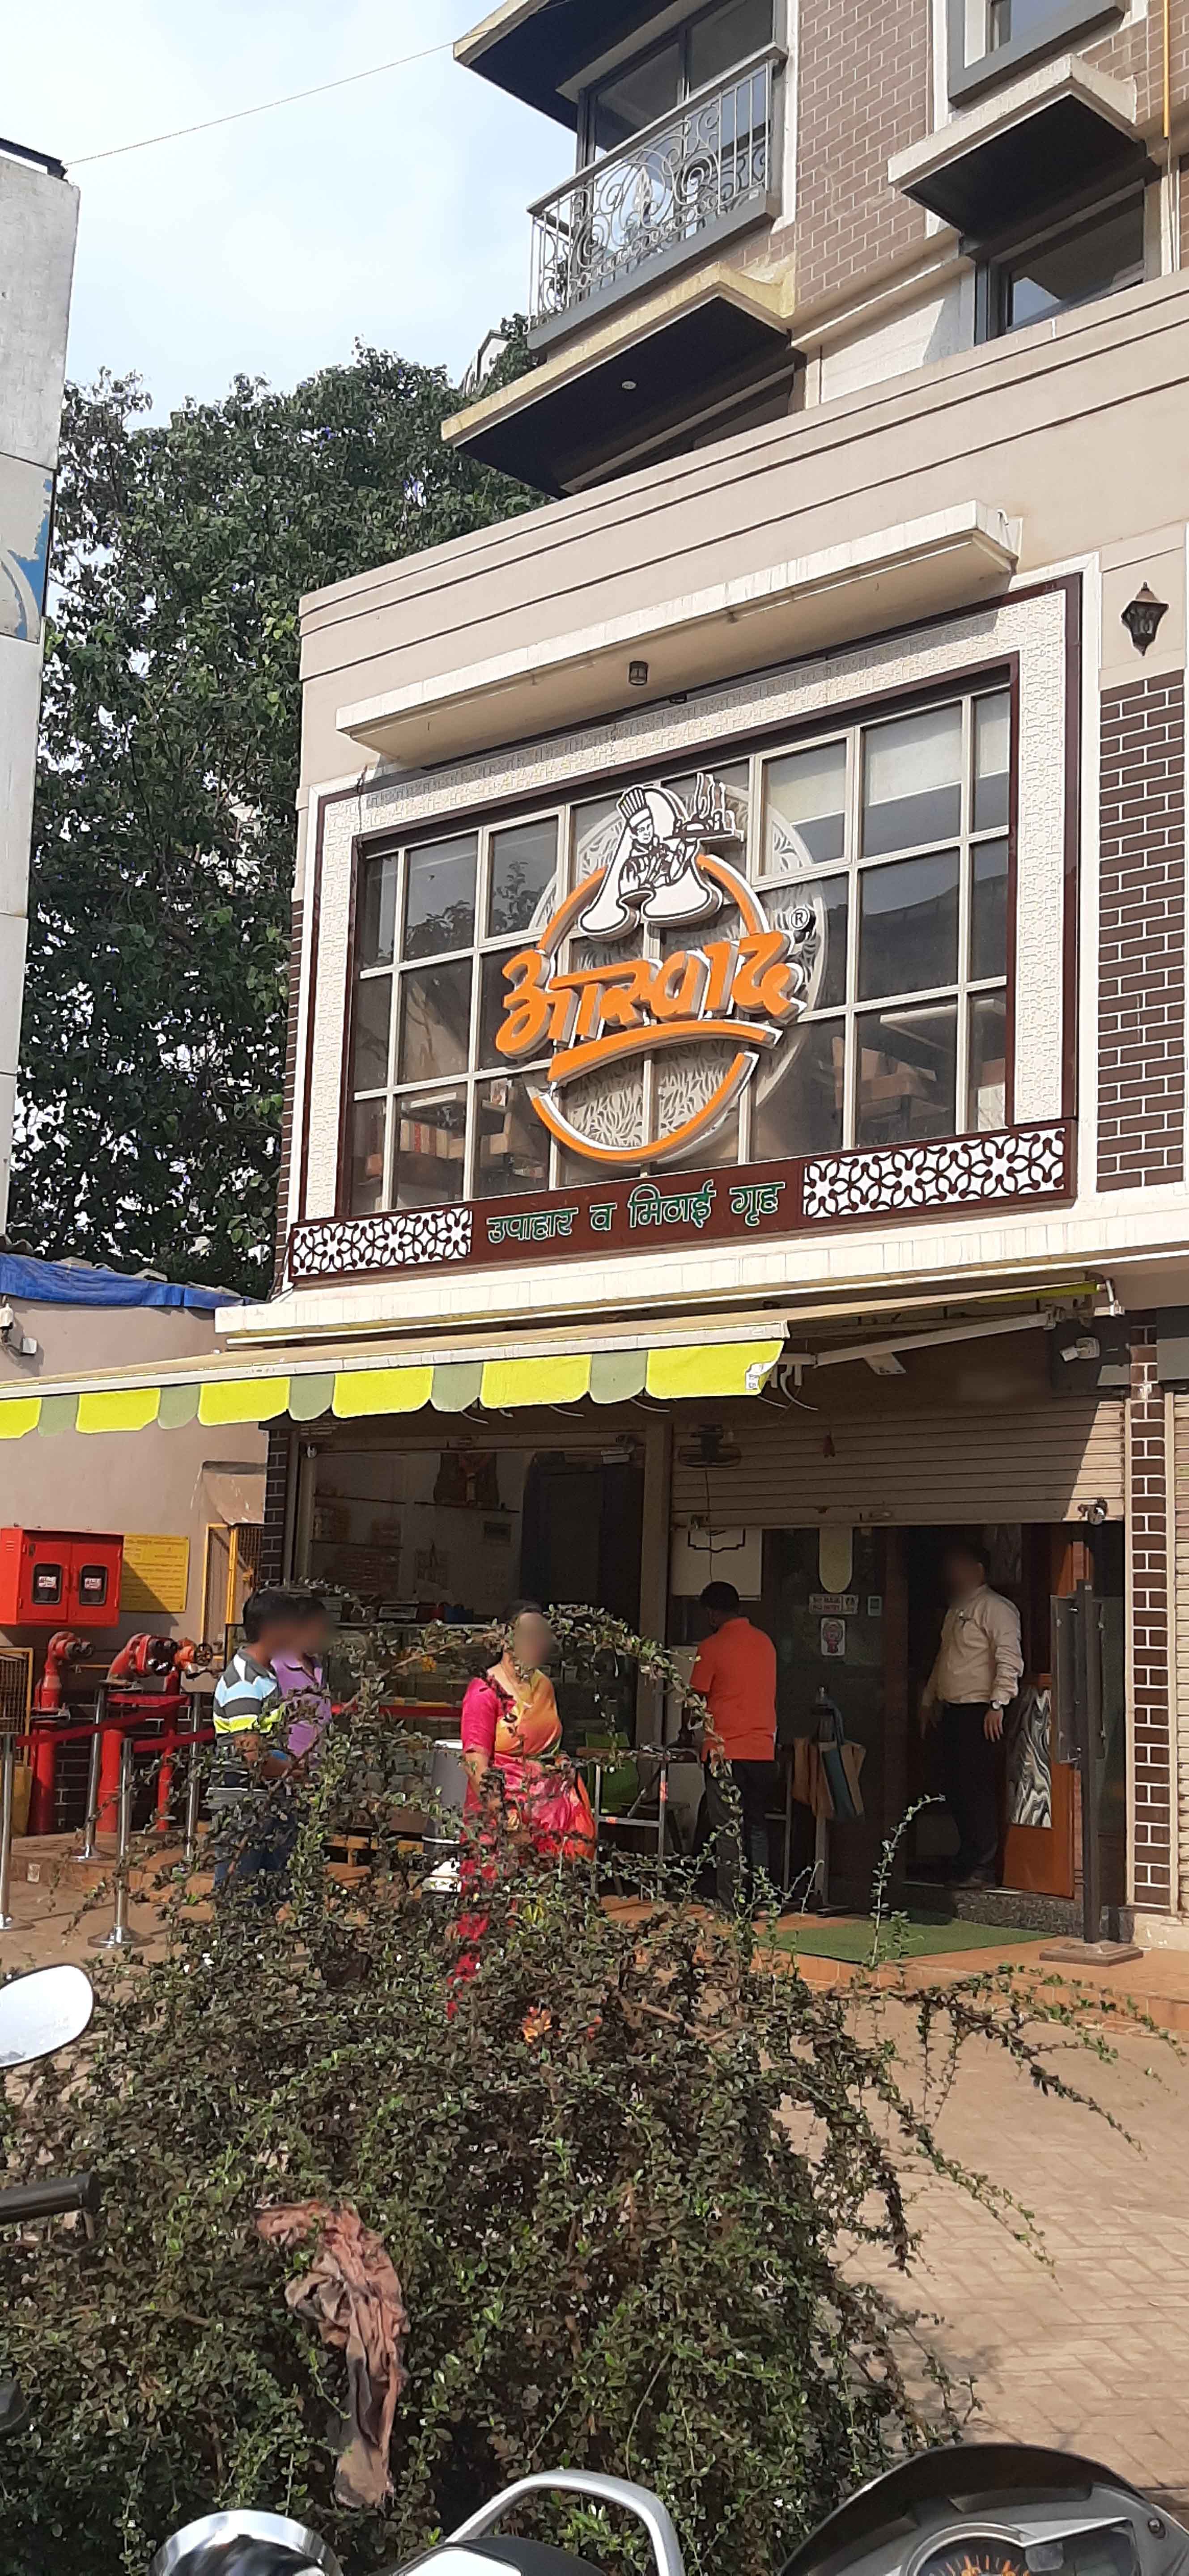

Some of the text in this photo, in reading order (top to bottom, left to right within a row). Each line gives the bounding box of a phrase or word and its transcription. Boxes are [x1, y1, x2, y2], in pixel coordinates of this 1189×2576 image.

[495, 930, 800, 1055] आस्वाद
[488, 1179, 786, 1244] उपाहार व मिठाई गृह
